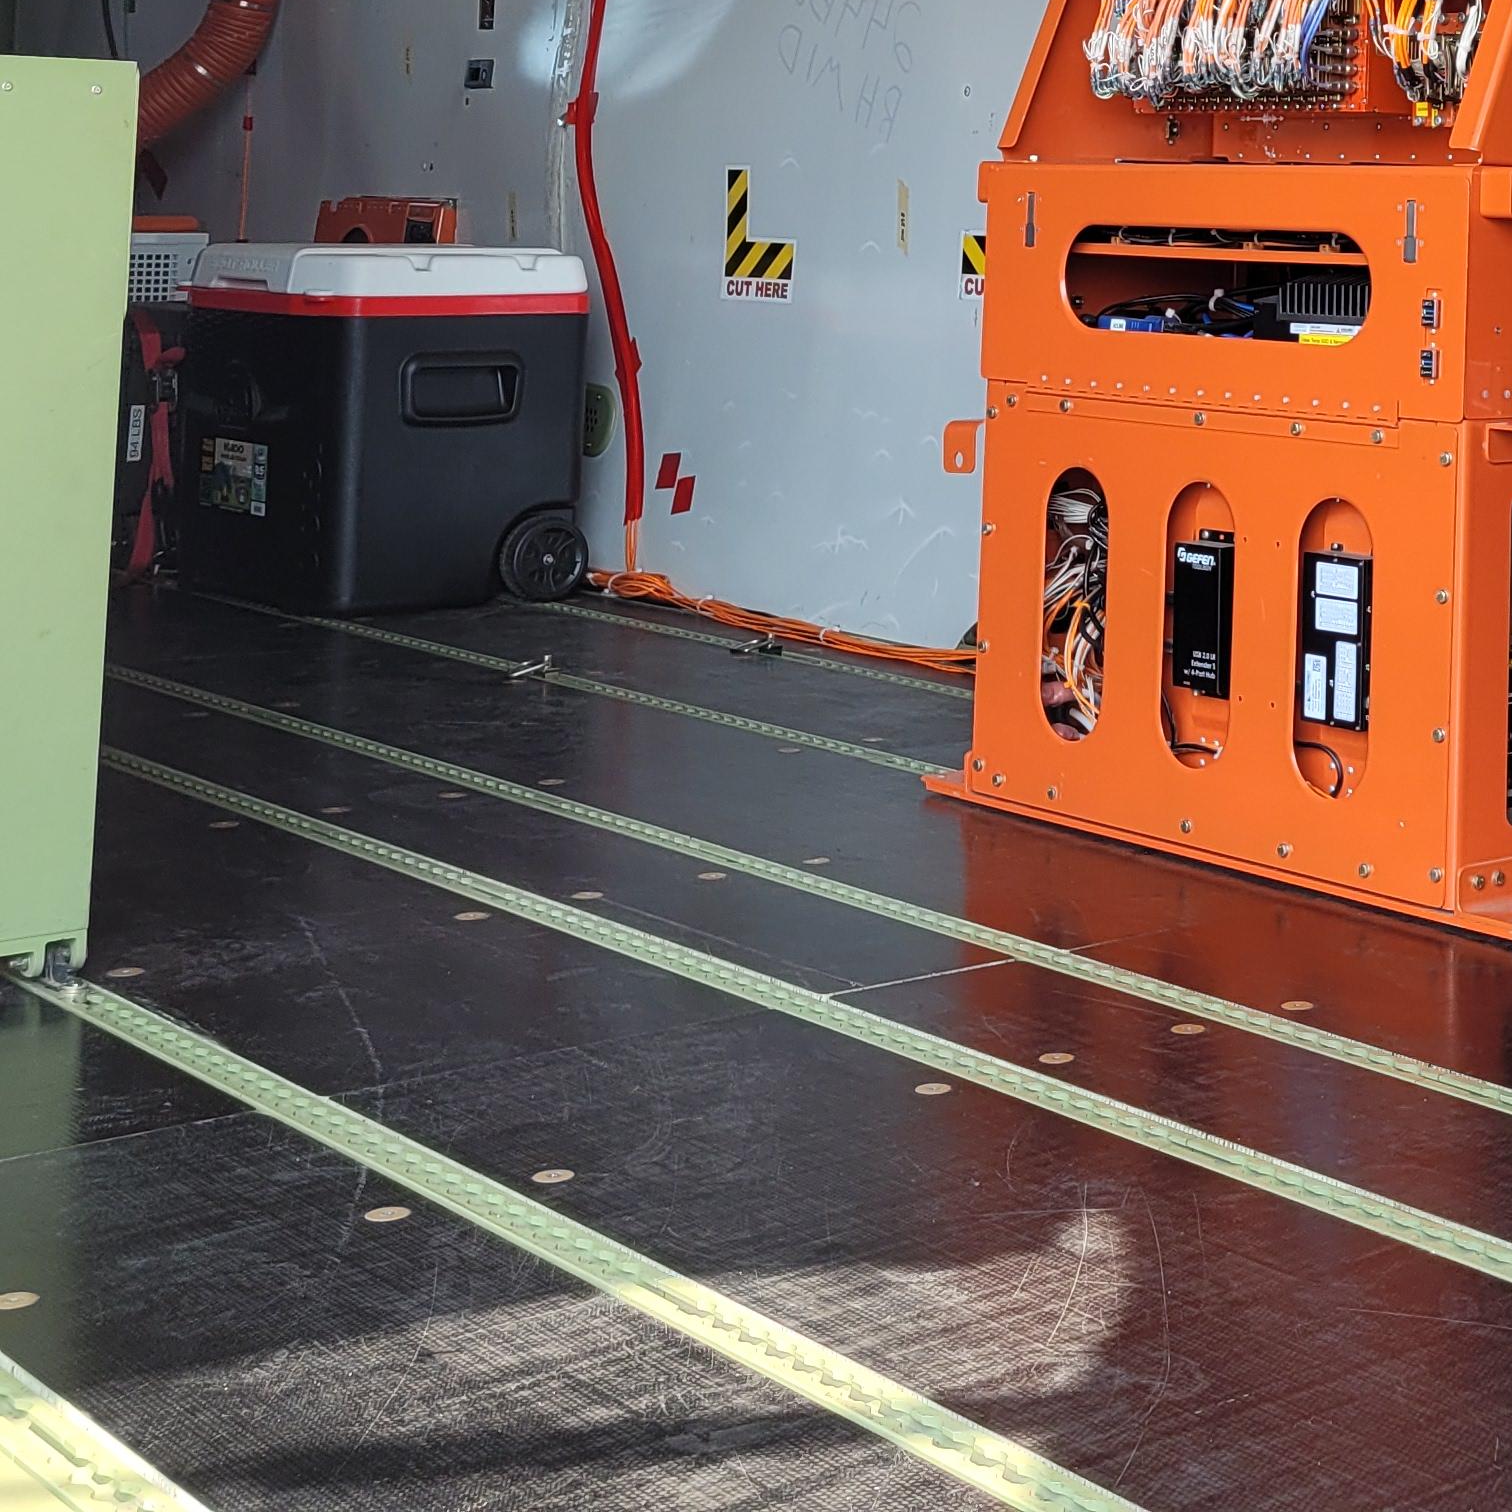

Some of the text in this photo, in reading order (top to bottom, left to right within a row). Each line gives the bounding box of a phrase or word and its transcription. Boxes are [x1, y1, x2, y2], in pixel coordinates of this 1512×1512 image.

[726, 280, 789, 300] CUT HERE
[964, 277, 985, 295] CU
[129, 407, 142, 458] 94 LBS
[1186, 552, 1216, 566] GEFEN
[1206, 670, 1216, 679] Hub
